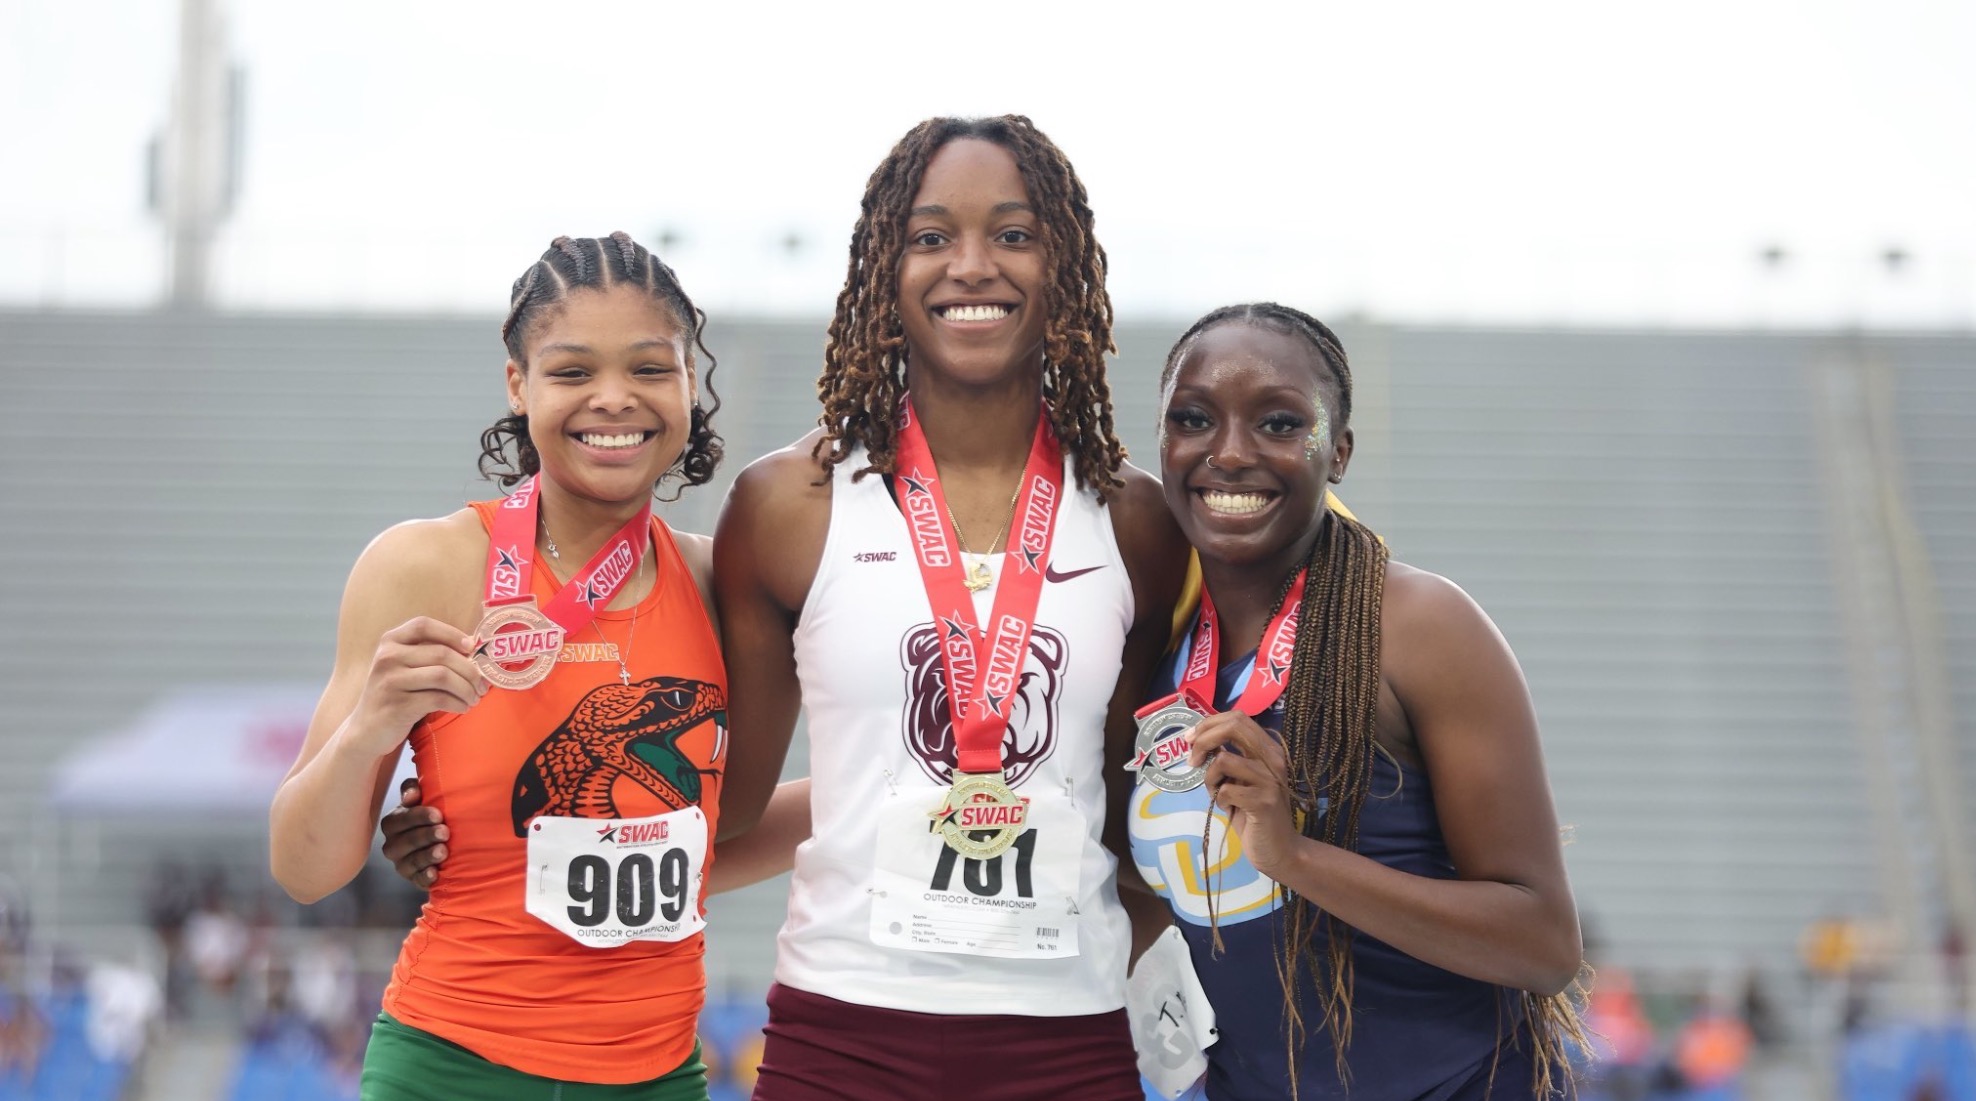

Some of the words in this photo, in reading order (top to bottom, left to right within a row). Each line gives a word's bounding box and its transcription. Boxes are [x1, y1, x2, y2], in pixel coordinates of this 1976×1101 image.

[1023, 475, 1056, 551] SWAC
[906, 493, 951, 567] SWAC
[594, 540, 635, 596] SWAC
[863, 551, 897, 563] SWAC
[492, 567, 520, 599] SW
[493, 630, 560, 658] SWAC
[1269, 601, 1301, 665] SW
[560, 643, 620, 662] SWAC
[986, 615, 1027, 694] SWAC
[1187, 628, 1213, 681] SWAC
[1156, 735, 1194, 766] SW
[961, 805, 1023, 826] SWAC
[619, 820, 669, 844] SWAC
[566, 847, 690, 927] 909
[924, 893, 969, 905] OUTDOOR
[972, 896, 1038, 910] CHAMPIONSHIP
[577, 929, 623, 938] OUTDOOR
